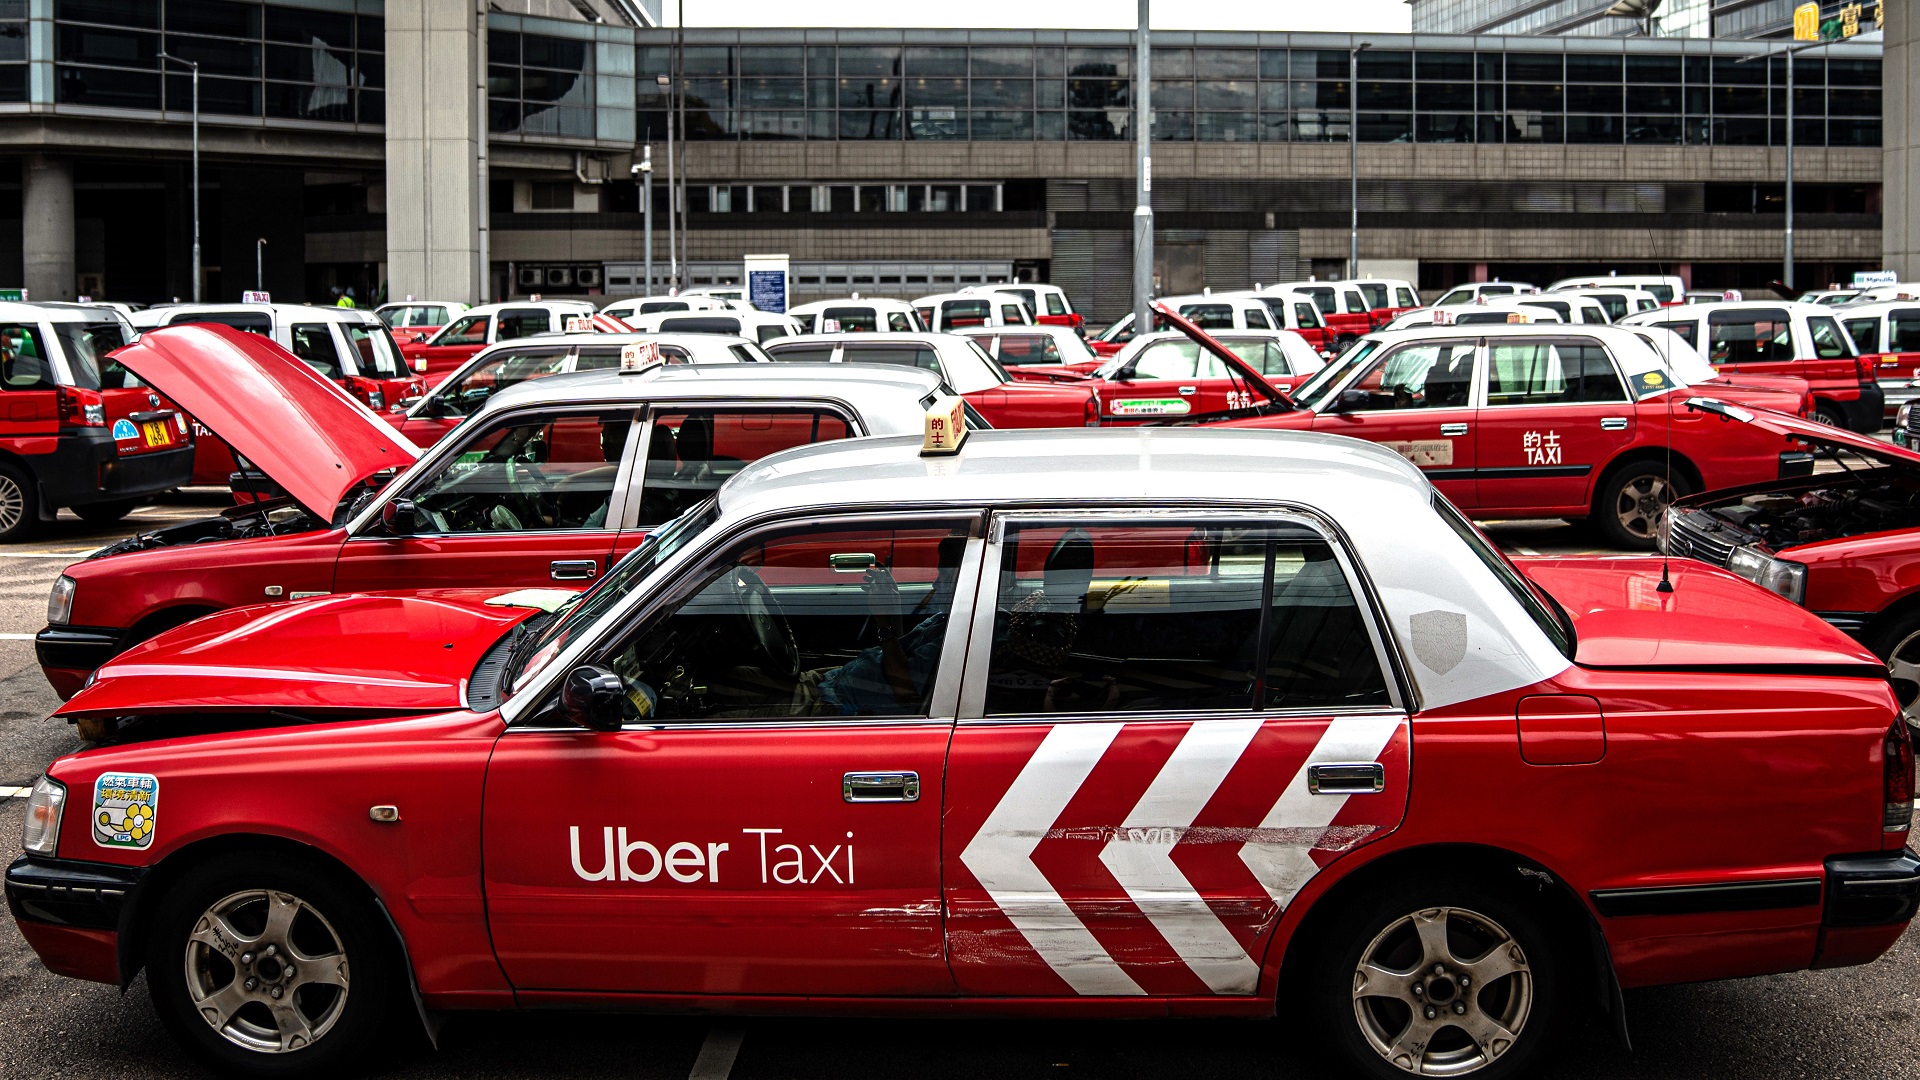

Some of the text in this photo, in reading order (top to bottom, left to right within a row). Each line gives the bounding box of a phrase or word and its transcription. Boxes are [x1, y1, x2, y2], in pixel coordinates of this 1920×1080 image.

[252, 292, 269, 302] TAXI
[578, 319, 593, 331] TAXI
[625, 351, 635, 367] 的士
[639, 342, 660, 366] TAXI
[149, 422, 160, 434] YB
[192, 422, 213, 437] TA
[931, 418, 944, 444] 的士
[150, 433, 166, 446] 1691
[1523, 429, 1561, 447] 的士
[1523, 447, 1562, 465] TAXI
[102, 775, 153, 789] 燃氣車輛
[101, 788, 152, 802] 環境清新
[570, 825, 854, 884] Uber Taxi
